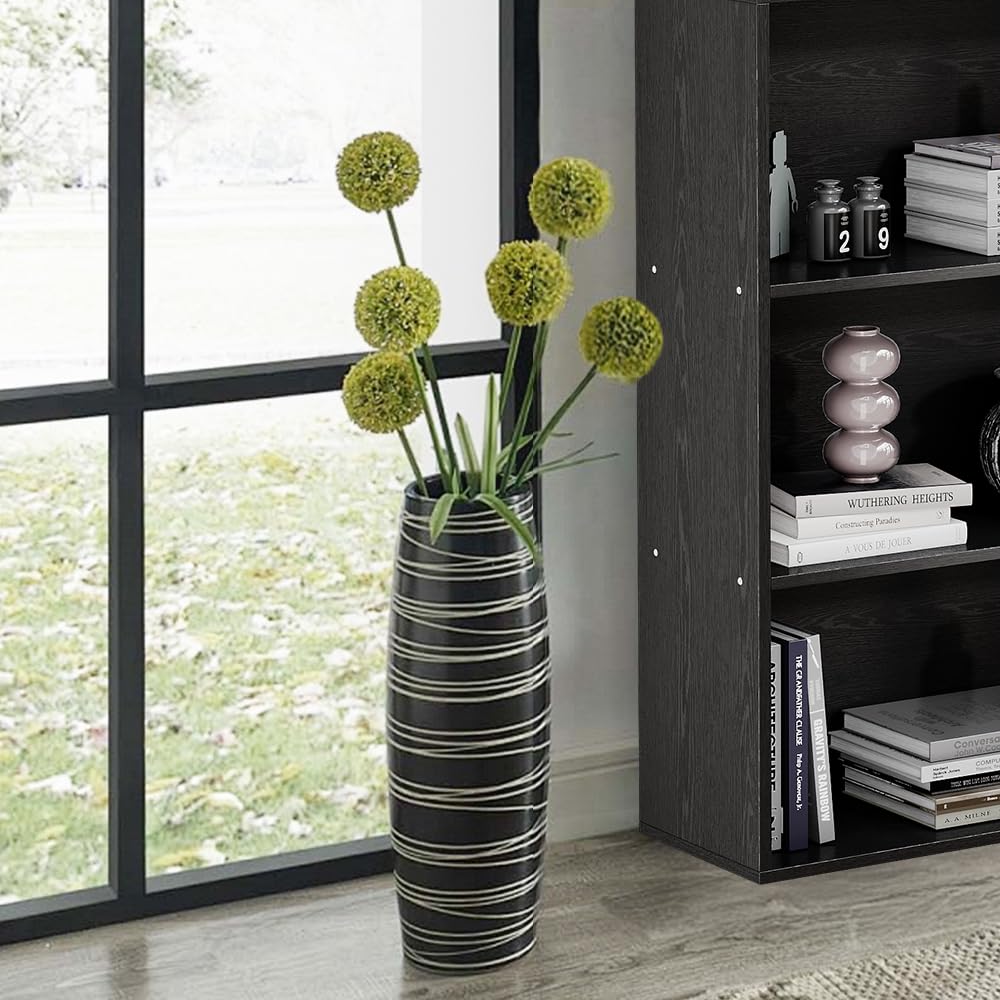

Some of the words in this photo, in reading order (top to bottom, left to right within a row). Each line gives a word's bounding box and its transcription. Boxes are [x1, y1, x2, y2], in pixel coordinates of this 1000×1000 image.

[839, 230, 850, 253] 2
[878, 227, 889, 250] 9
[847, 495, 907, 509] WUTHERING
[912, 491, 954, 505] HEIGHTS
[835, 519, 874, 530] Constructing
[875, 516, 901, 526] Paradies
[851, 543, 873, 553] VOUS
[875, 540, 887, 550] DE
[887, 536, 912, 550] JOUER
[795, 655, 803, 669] THE
[795, 669, 803, 719] GRANDFATHER
[795, 719, 803, 747] CLAUSE
[813, 718, 827, 773] GRAVITY'S
[954, 747, 975, 757] John
[818, 774, 831, 822] RAINBOW
[964, 811, 990, 820] MILNE
